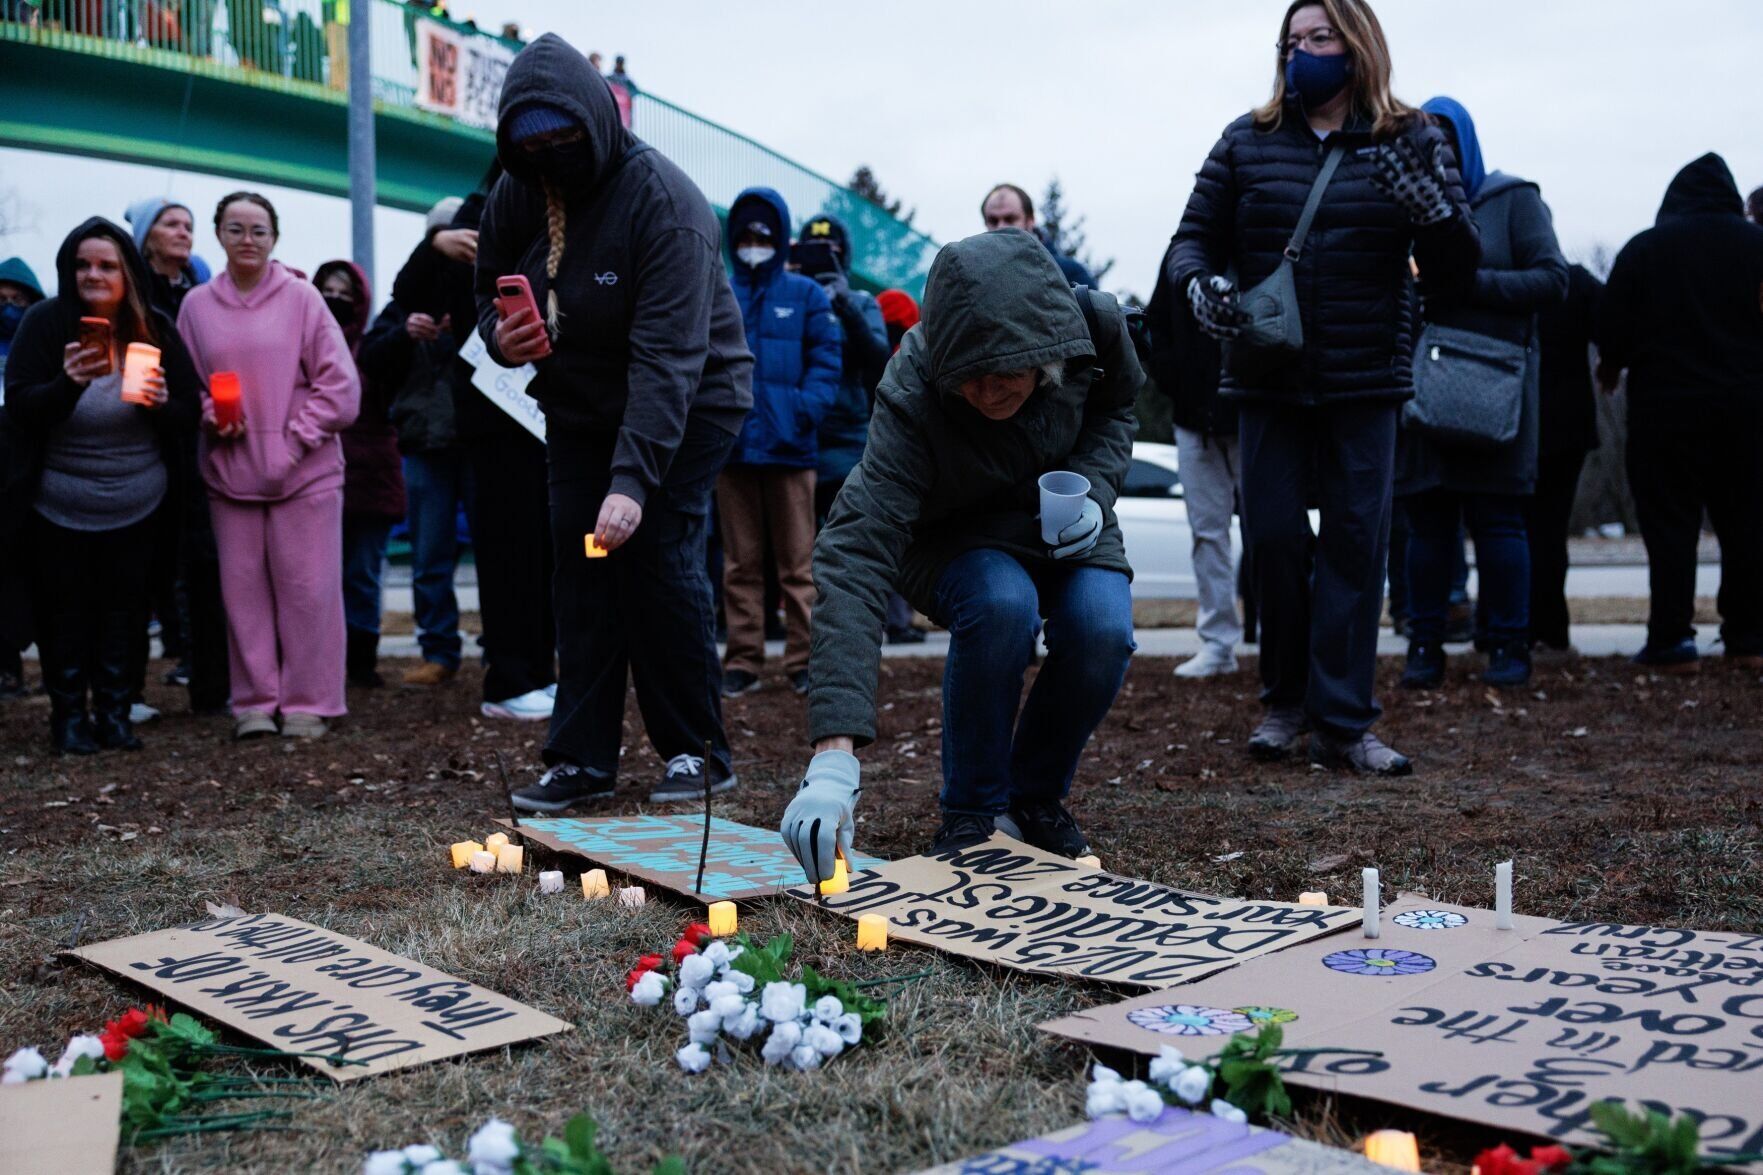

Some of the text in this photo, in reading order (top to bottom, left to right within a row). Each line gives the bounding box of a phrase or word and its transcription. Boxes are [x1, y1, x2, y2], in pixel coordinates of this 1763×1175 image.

[889, 909, 1021, 950] was
[908, 871, 1298, 954] Deadliest
[129, 952, 250, 983] IDF
[250, 937, 350, 963] all
[1000, 941, 1233, 981] 2025
[315, 958, 422, 988] are
[385, 982, 518, 1040] They
[1391, 1006, 1528, 1045] the
[1506, 997, 1725, 1037] over
[1544, 1028, 1620, 1057] in
[1524, 1057, 1626, 1086] 3
